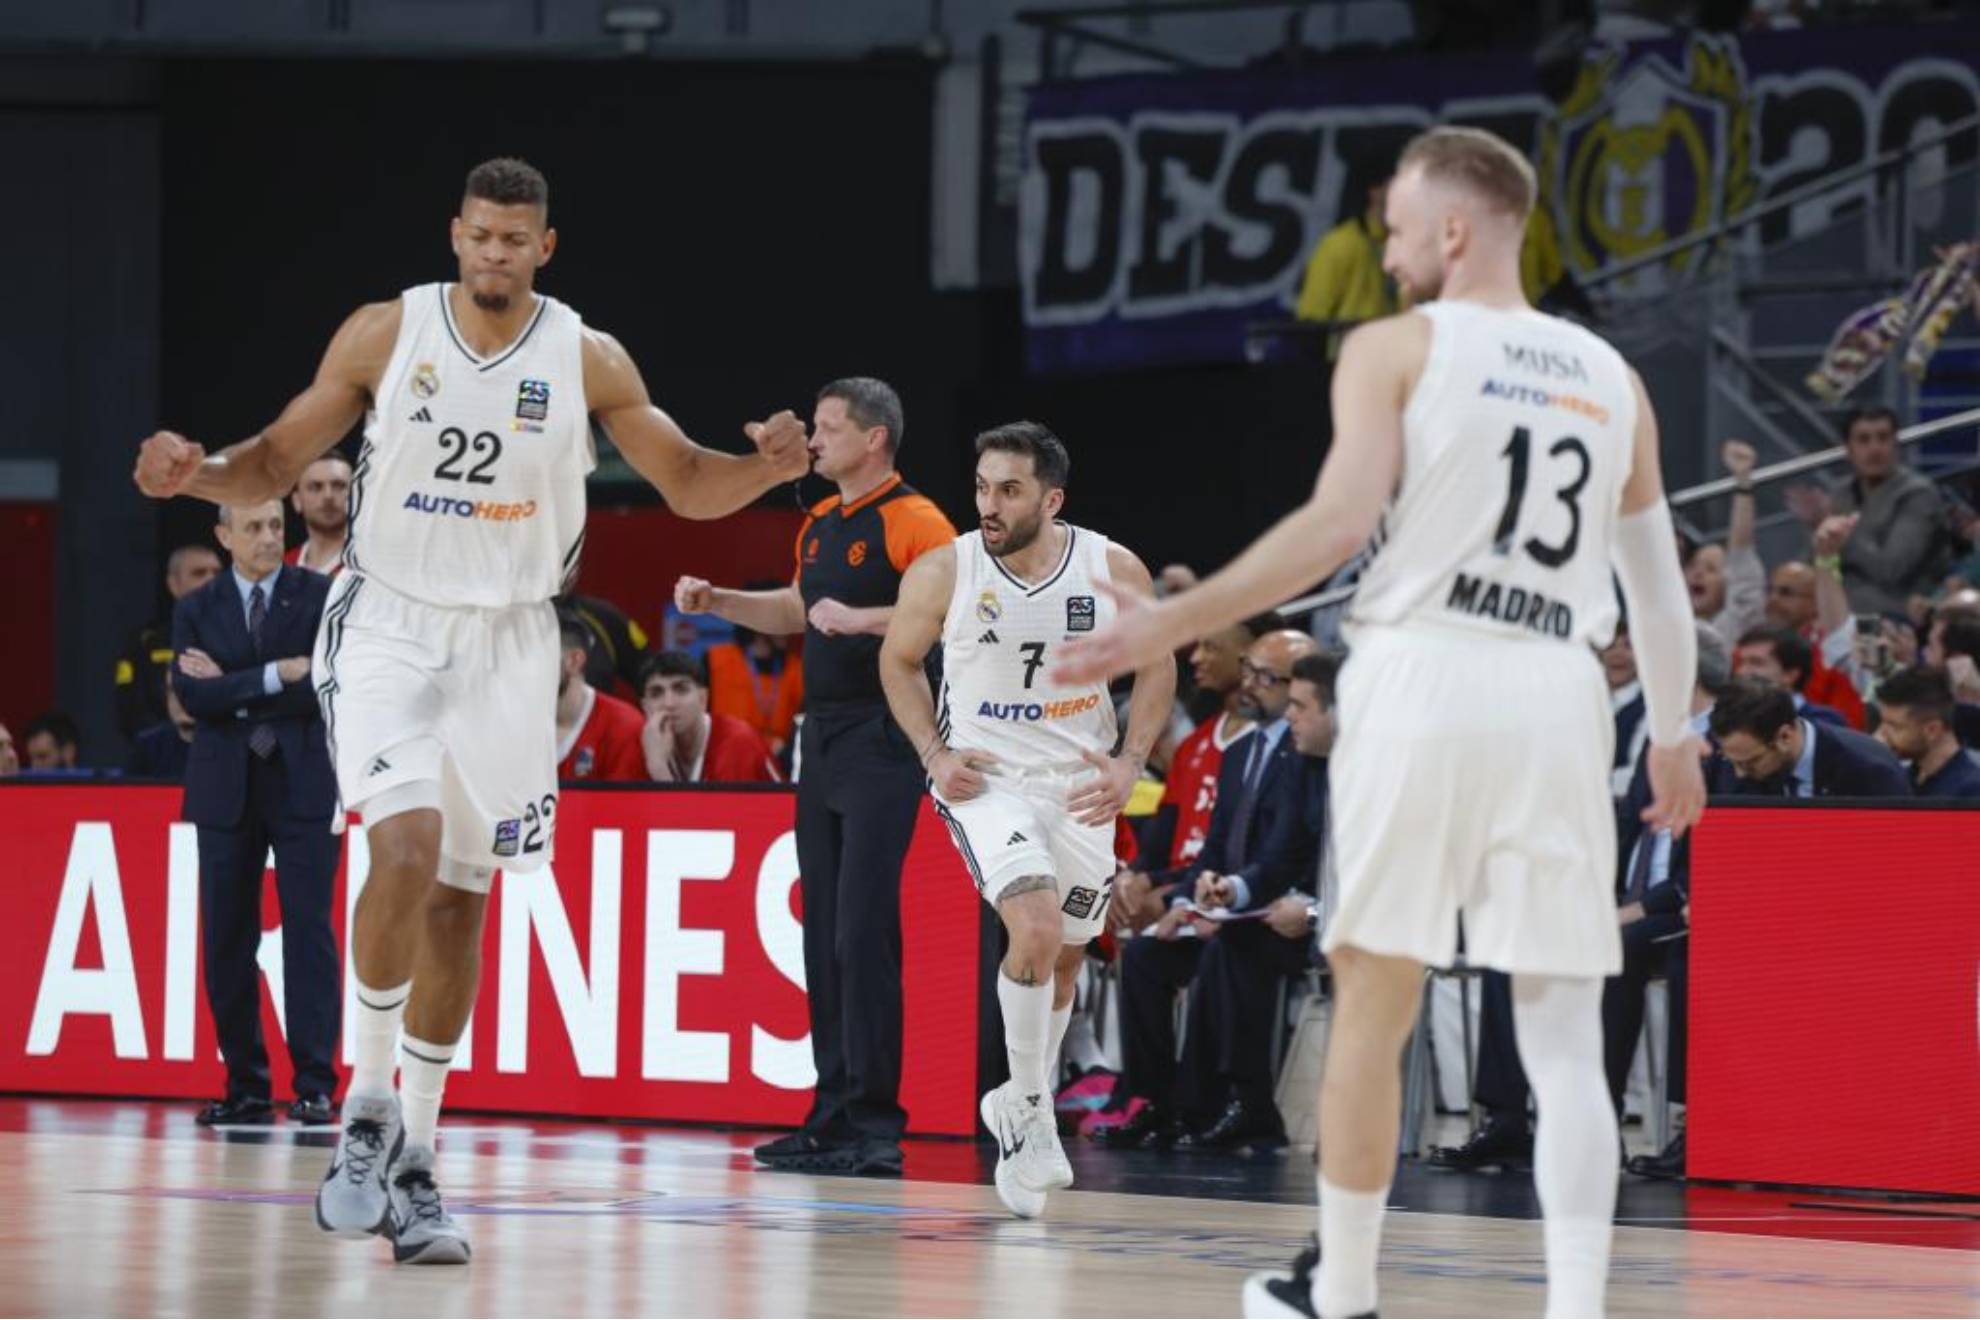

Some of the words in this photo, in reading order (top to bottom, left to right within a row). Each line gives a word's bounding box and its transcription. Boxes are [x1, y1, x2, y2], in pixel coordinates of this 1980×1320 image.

[1502, 342, 1590, 386] MUSA
[1479, 376, 1611, 426] AUTOHERO
[433, 426, 503, 485] 22
[403, 492, 538, 523] AUTOHERO
[1493, 424, 1592, 570] 13
[1445, 572, 1573, 640] MADRID
[1019, 641, 1047, 690] 7
[977, 694, 1099, 722] AUTOHERO
[25, 821, 819, 1090] AINES
